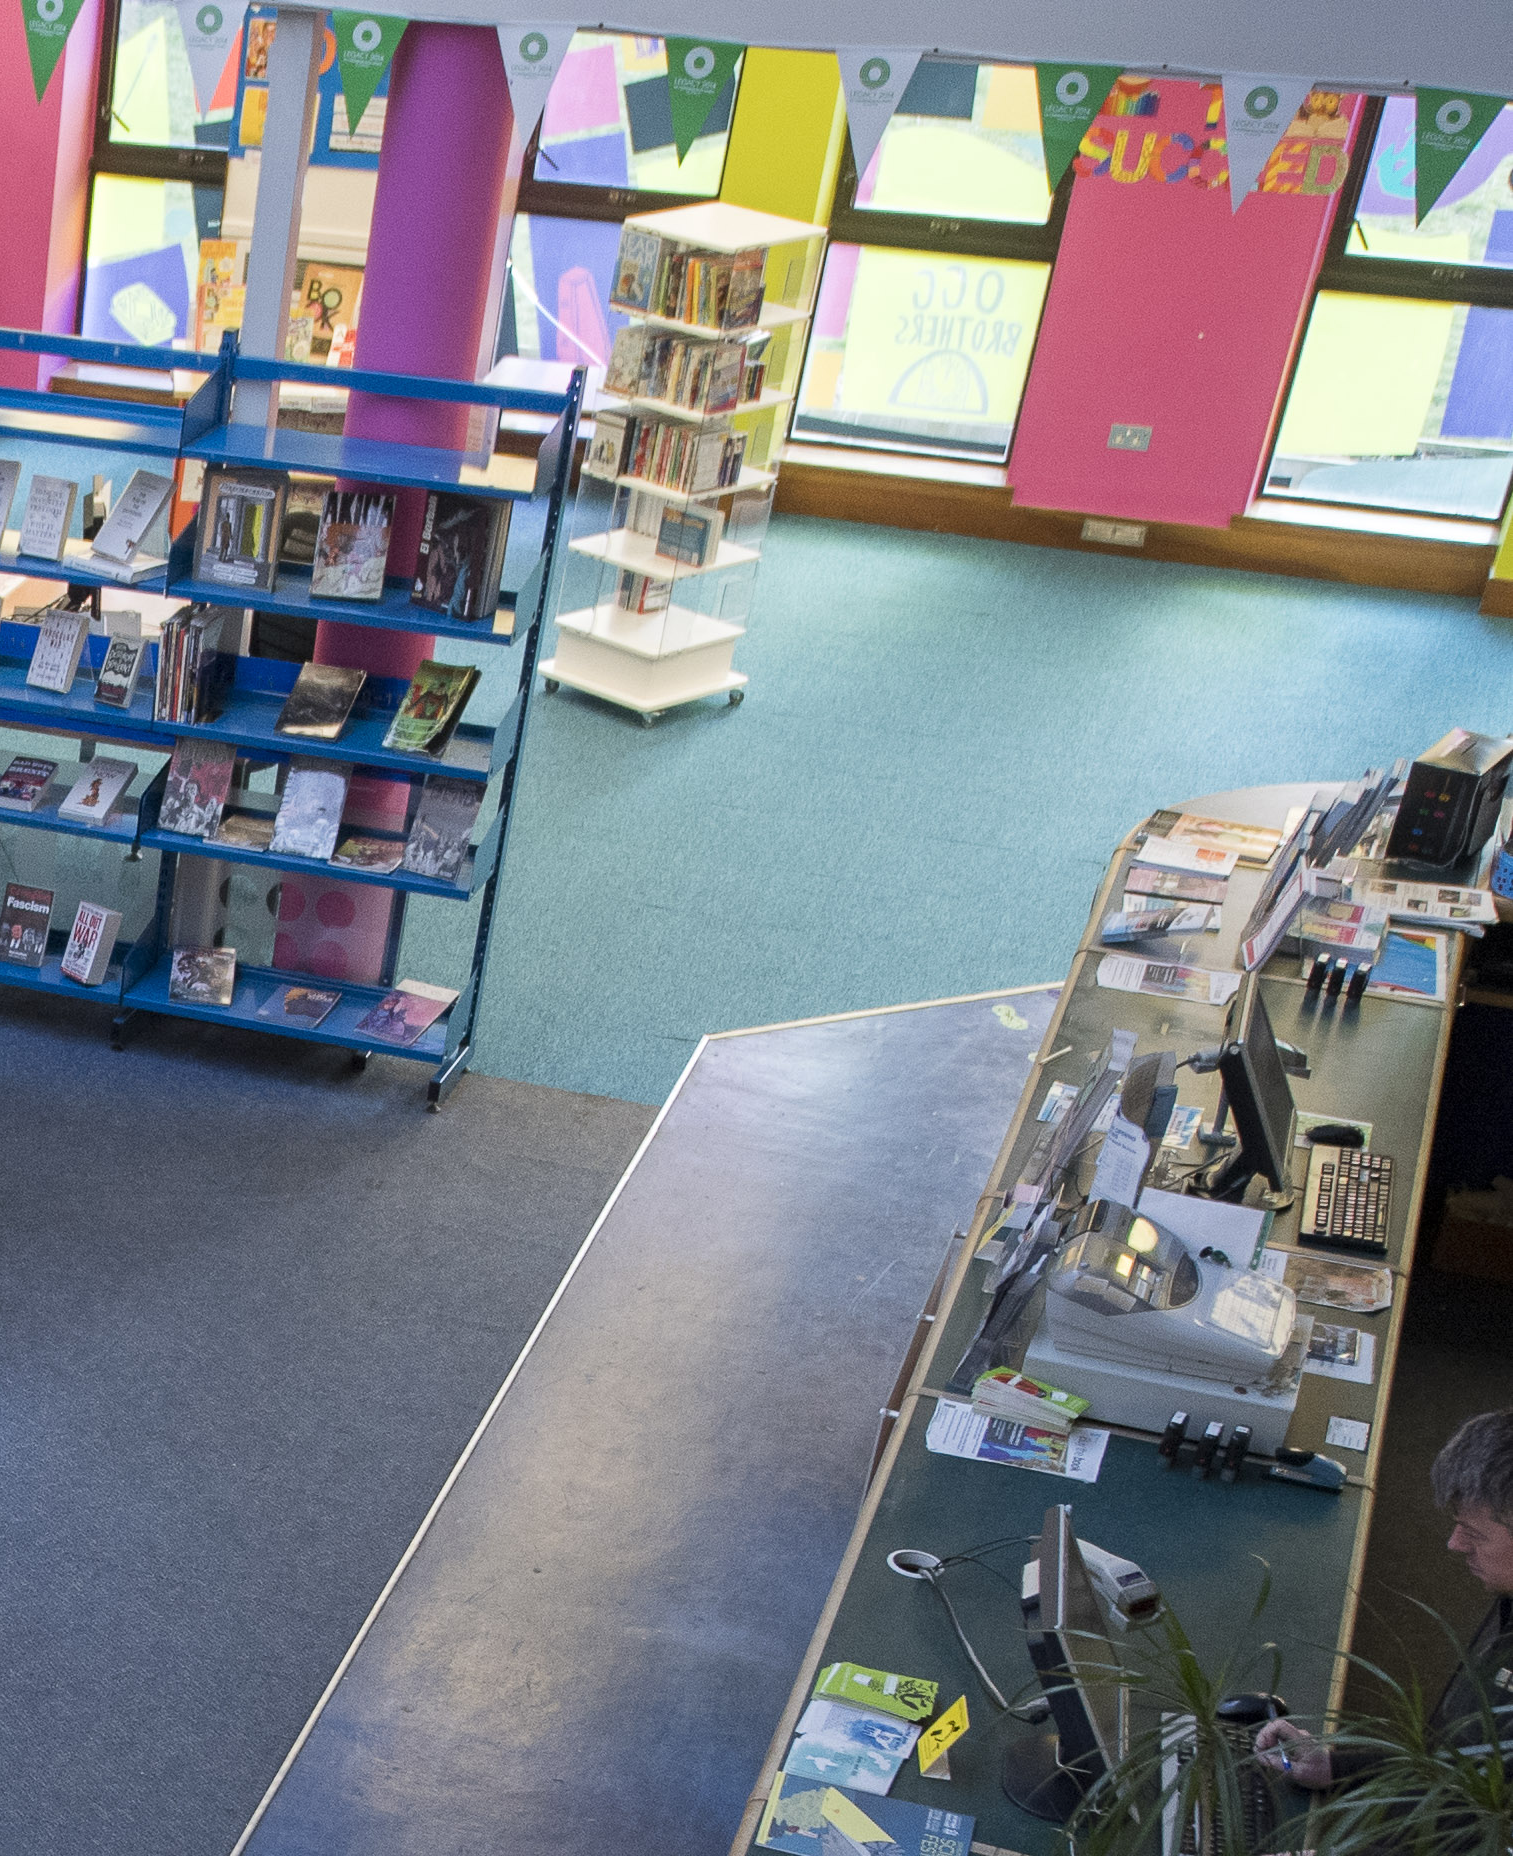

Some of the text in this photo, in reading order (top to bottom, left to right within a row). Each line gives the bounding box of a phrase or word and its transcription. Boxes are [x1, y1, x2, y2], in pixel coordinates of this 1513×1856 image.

[7, 896, 50, 915] Fascism
[77, 910, 102, 930] ALL OUT
[73, 924, 99, 949] WAR
